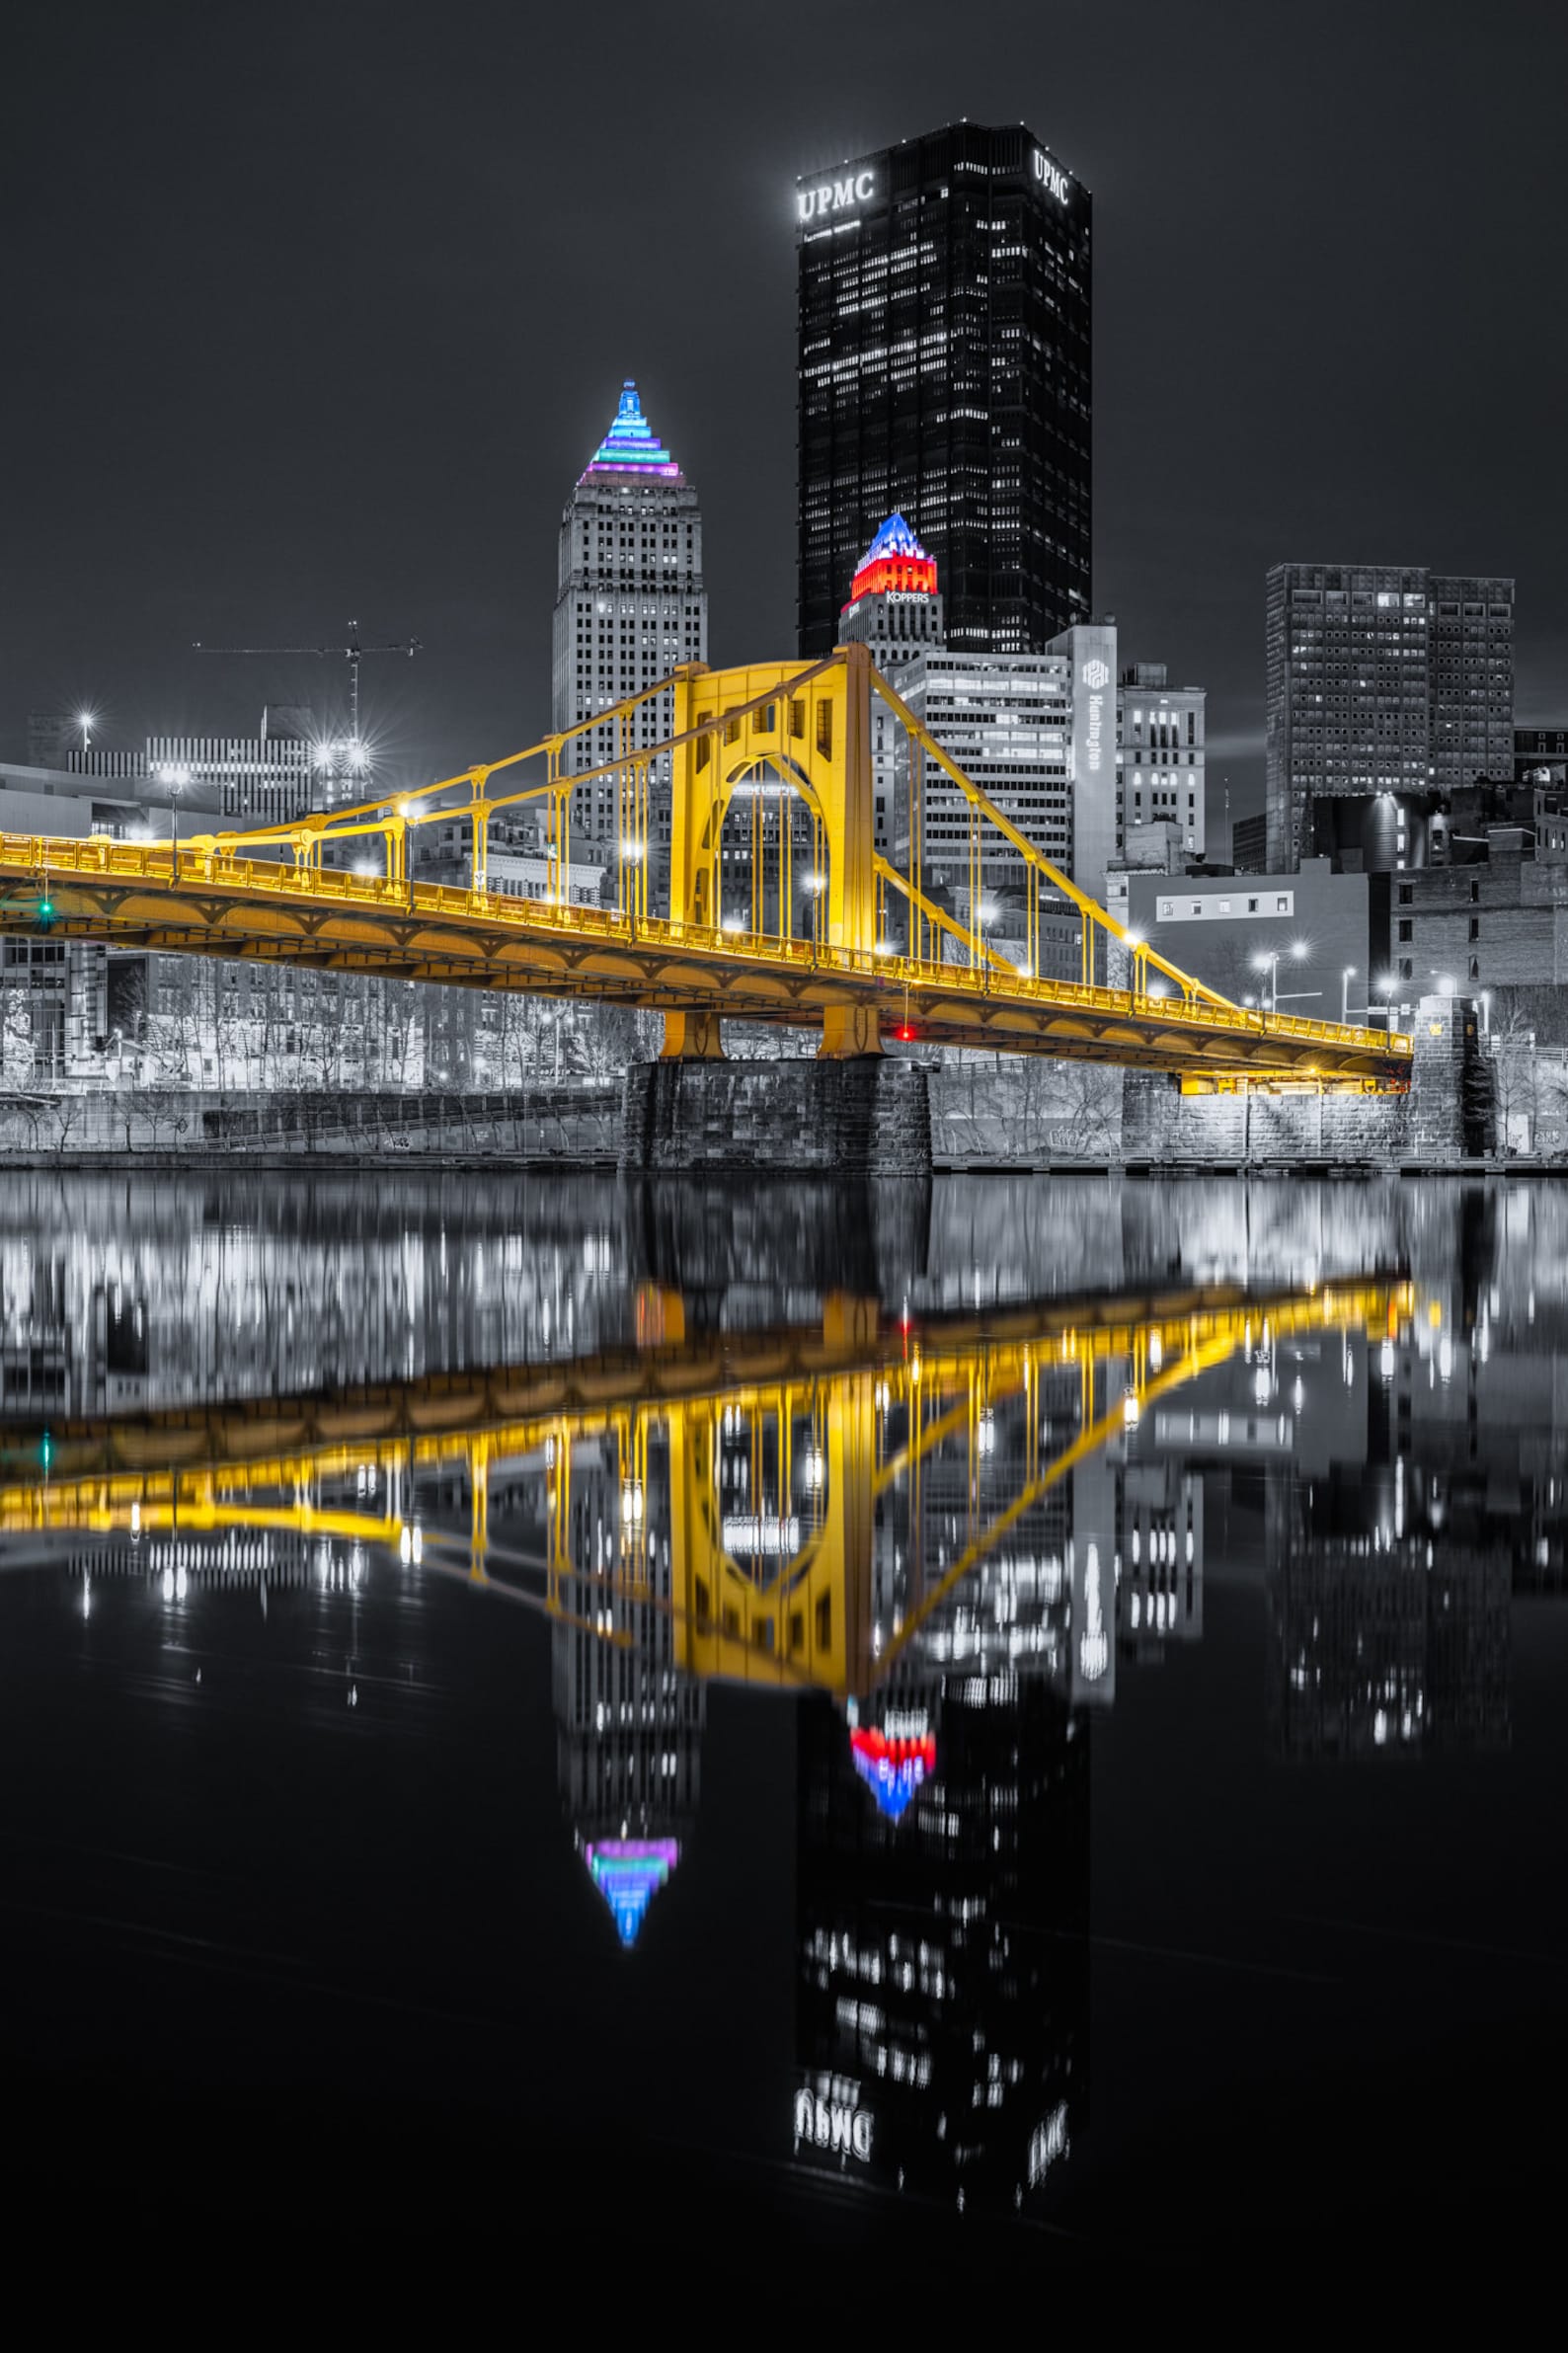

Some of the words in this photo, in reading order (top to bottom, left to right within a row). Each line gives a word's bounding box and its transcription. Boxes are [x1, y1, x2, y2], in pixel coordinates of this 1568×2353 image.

[797, 173, 873, 219] UPMC
[1034, 150, 1068, 204] UPMC
[886, 590, 929, 603] KOPPERS
[1086, 695, 1104, 770] Huntington
